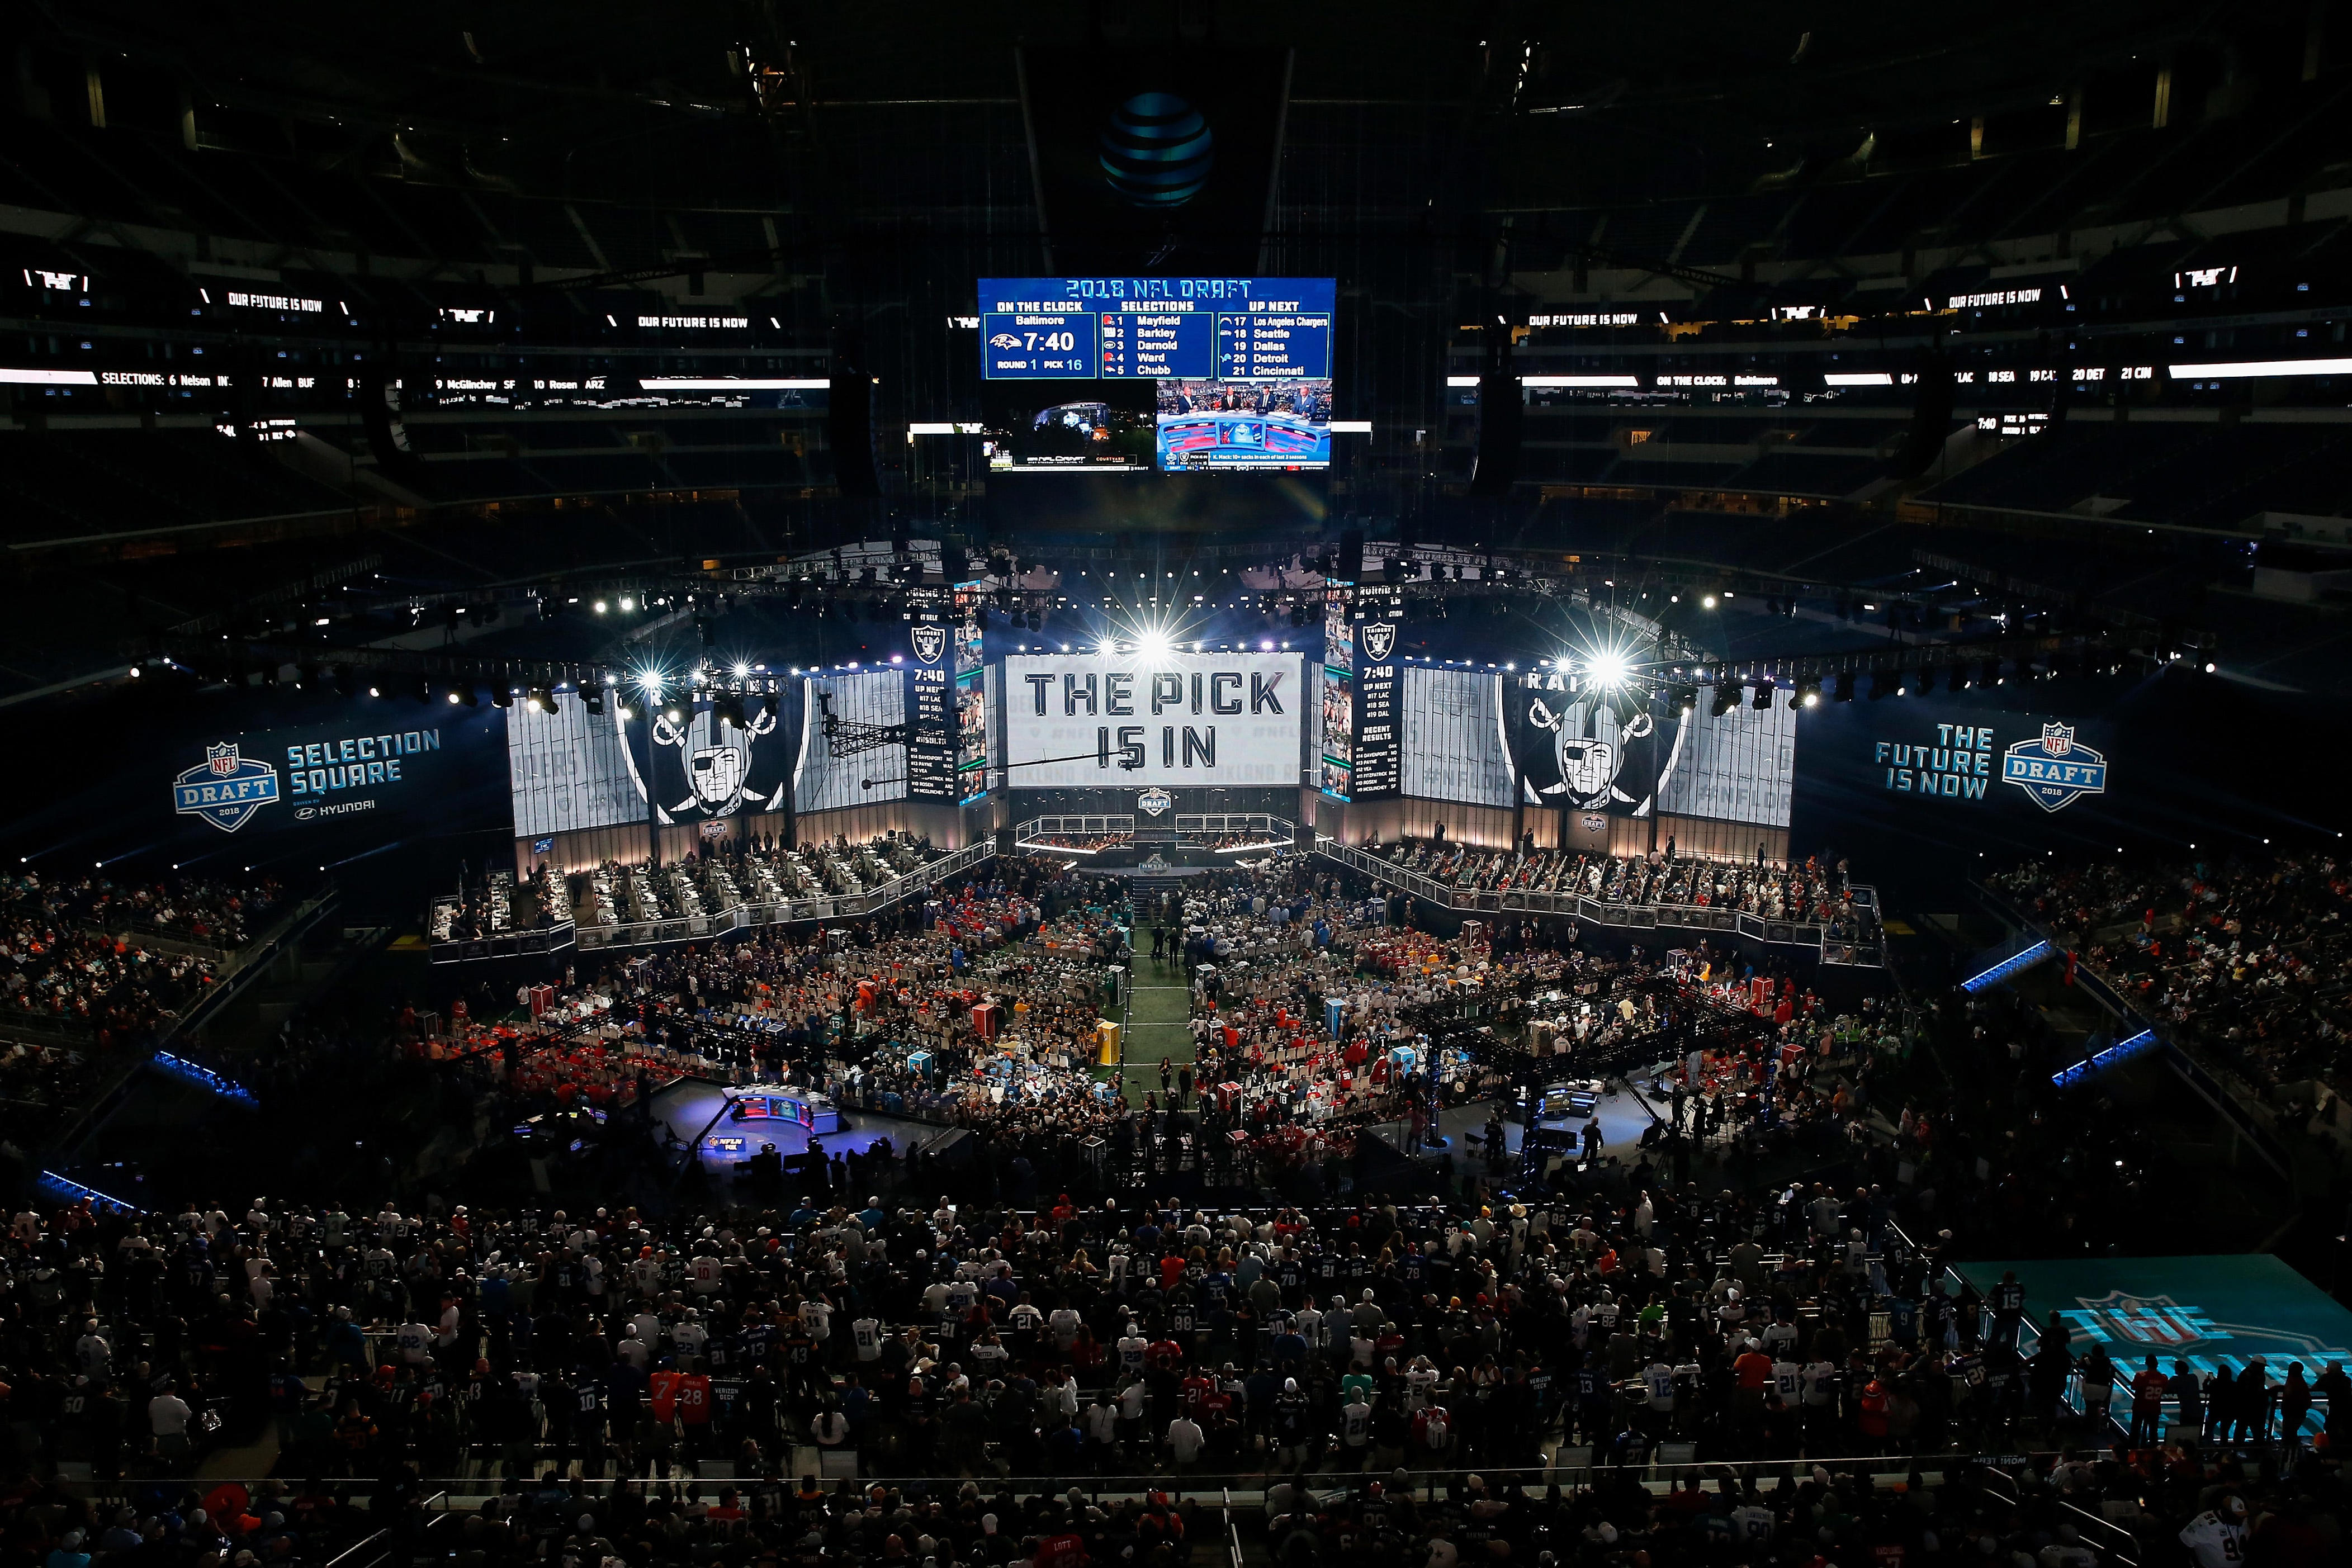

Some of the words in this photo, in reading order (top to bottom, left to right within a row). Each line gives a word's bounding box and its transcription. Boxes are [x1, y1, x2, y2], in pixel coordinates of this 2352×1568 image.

[1066, 280, 1124, 299] 2018
[1133, 280, 1173, 299] NFL
[1180, 280, 1252, 299] DRAFT
[229, 292, 248, 307] OUR
[251, 295, 288, 310] FUTURE
[290, 296, 300, 311] IS
[301, 298, 322, 312] NOW
[1949, 296, 1965, 309] OUR
[1968, 293, 2004, 308] FUTURE
[2006, 291, 2015, 304] IS
[2018, 289, 2040, 302] NOW
[997, 302, 1014, 312] ON
[1017, 302, 1040, 312] THE
[1043, 302, 1082, 312] CLOCK
[1121, 302, 1194, 312] SELECTIONS
[1249, 301, 1265, 311] UP
[1268, 301, 1299, 311] NEXT
[638, 316, 660, 328] OUR
[662, 317, 706, 328] FUTURE
[709, 317, 720, 328] IS
[722, 318, 747, 328] NOW
[1016, 316, 1064, 325] Baltimore
[1117, 316, 1123, 325] 1
[1137, 316, 1180, 326] Mayfield
[1234, 317, 1246, 325] 17
[1253, 317, 1266, 326] Los
[1267, 317, 1295, 328] Angeles
[1296, 317, 1327, 328] Chargers
[1529, 315, 1551, 326] OUR
[1553, 315, 1597, 325] FUTURE
[1599, 314, 1610, 325] IS
[1612, 313, 1637, 324] NOW
[1117, 329, 1124, 337] 2
[1137, 329, 1176, 339] Barkley
[1234, 329, 1246, 338] 18
[1253, 329, 1290, 338] Seattle
[1024, 332, 1074, 351] 7:40
[1117, 341, 1124, 350] 3
[1137, 342, 1177, 350] Darnold
[1234, 342, 1246, 350] 19
[1253, 342, 1285, 350] Dallas
[1117, 353, 1124, 362] 4
[1137, 353, 1165, 362] Ward
[1233, 354, 1246, 363] 20
[1253, 354, 1288, 363] Detroit
[997, 361, 1026, 369] ROUND
[1030, 359, 1036, 370] 1
[1044, 361, 1064, 369] PICK
[1067, 359, 1082, 370] 16
[1117, 366, 1124, 375] 5
[1137, 366, 1171, 375] Chubb
[1233, 366, 1245, 375] 21
[1252, 366, 1304, 375] Cincinnati
[102, 372, 164, 386] SELECTIONS:
[169, 375, 176, 386] 6
[181, 375, 210, 386] Nelson
[1958, 372, 1974, 383] LAC
[1998, 371, 2015, 382] SEA
[2073, 368, 2085, 380] 20
[2086, 368, 2104, 380] DET
[2122, 368, 2132, 380] 21
[2135, 367, 2151, 379] CIN
[263, 377, 268, 387] 7
[272, 377, 292, 387] Allen
[298, 378, 314, 388] BUF
[348, 378, 353, 388] 8
[436, 380, 442, 389] 9
[447, 380, 496, 391] McGlinchey
[504, 381, 515, 389] SF
[534, 381, 545, 390] 10
[549, 380, 578, 390] Rosen
[585, 380, 604, 390] ARZ
[1657, 376, 1671, 386] ON
[1674, 376, 1692, 386] THE
[1694, 376, 1726, 386] CLOCK:
[1734, 376, 1778, 386] Baltimore
[1978, 418, 1996, 430] 7:40
[914, 669, 945, 681] 7:40
[1364, 666, 1393, 679] 7:40
[1025, 672, 1134, 716] THE
[1152, 672, 1285, 716] PICK
[1364, 725, 1390, 734] RECENT
[1362, 733, 1392, 742] RESULTS
[1937, 723, 1993, 751] THE
[288, 728, 439, 769] SELECTION
[1098, 726, 1145, 769] IS
[1163, 726, 1215, 768] IN
[2046, 738, 2067, 752] NFL
[212, 756, 236, 772] NFL
[1875, 741, 1990, 776] FUTURE
[291, 759, 402, 794] SQUARE
[2012, 761, 2097, 784] DRAFT
[1886, 768, 1913, 791] IS
[1919, 771, 1988, 800] NOW
[183, 780, 269, 805] DRAFT
[2042, 787, 2062, 796] 2018
[219, 807, 240, 816] 2018
[320, 799, 375, 816] HYUNDAI
[1552, 1213, 1567, 1226] 82
[396, 1225, 409, 1237] 21
[1137, 1261, 1151, 1276] 21
[1322, 1264, 1335, 1278] 21
[1281, 1274, 1296, 1286] 70
[2002, 1294, 2020, 1309] 15
[1017, 1314, 1031, 1329] 21
[1175, 1316, 1191, 1331] 88
[1602, 1315, 1615, 1328] 82
[941, 1321, 955, 1338] 21
[858, 1331, 872, 1346] 21
[676, 1342, 695, 1355] 22
[750, 1342, 765, 1356] 13
[791, 1347, 808, 1363] 43
[711, 1351, 726, 1365] 21
[1530, 1375, 1551, 1385] VERIZON
[1534, 1382, 1547, 1391] DECK
[1689, 1373, 1698, 1388] 4
[1780, 1375, 1795, 1394] 21
[468, 1382, 481, 1400] 43
[656, 1381, 670, 1399] 7
[1580, 1380, 1593, 1394] 13
[2145, 1386, 2162, 1400] 29
[579, 1394, 595, 1411] 10
[683, 1389, 702, 1405] 28
[1188, 1389, 1201, 1404] 21
[1351, 1418, 1365, 1435] 21
[1054, 1539, 1072, 1552] LOTT
